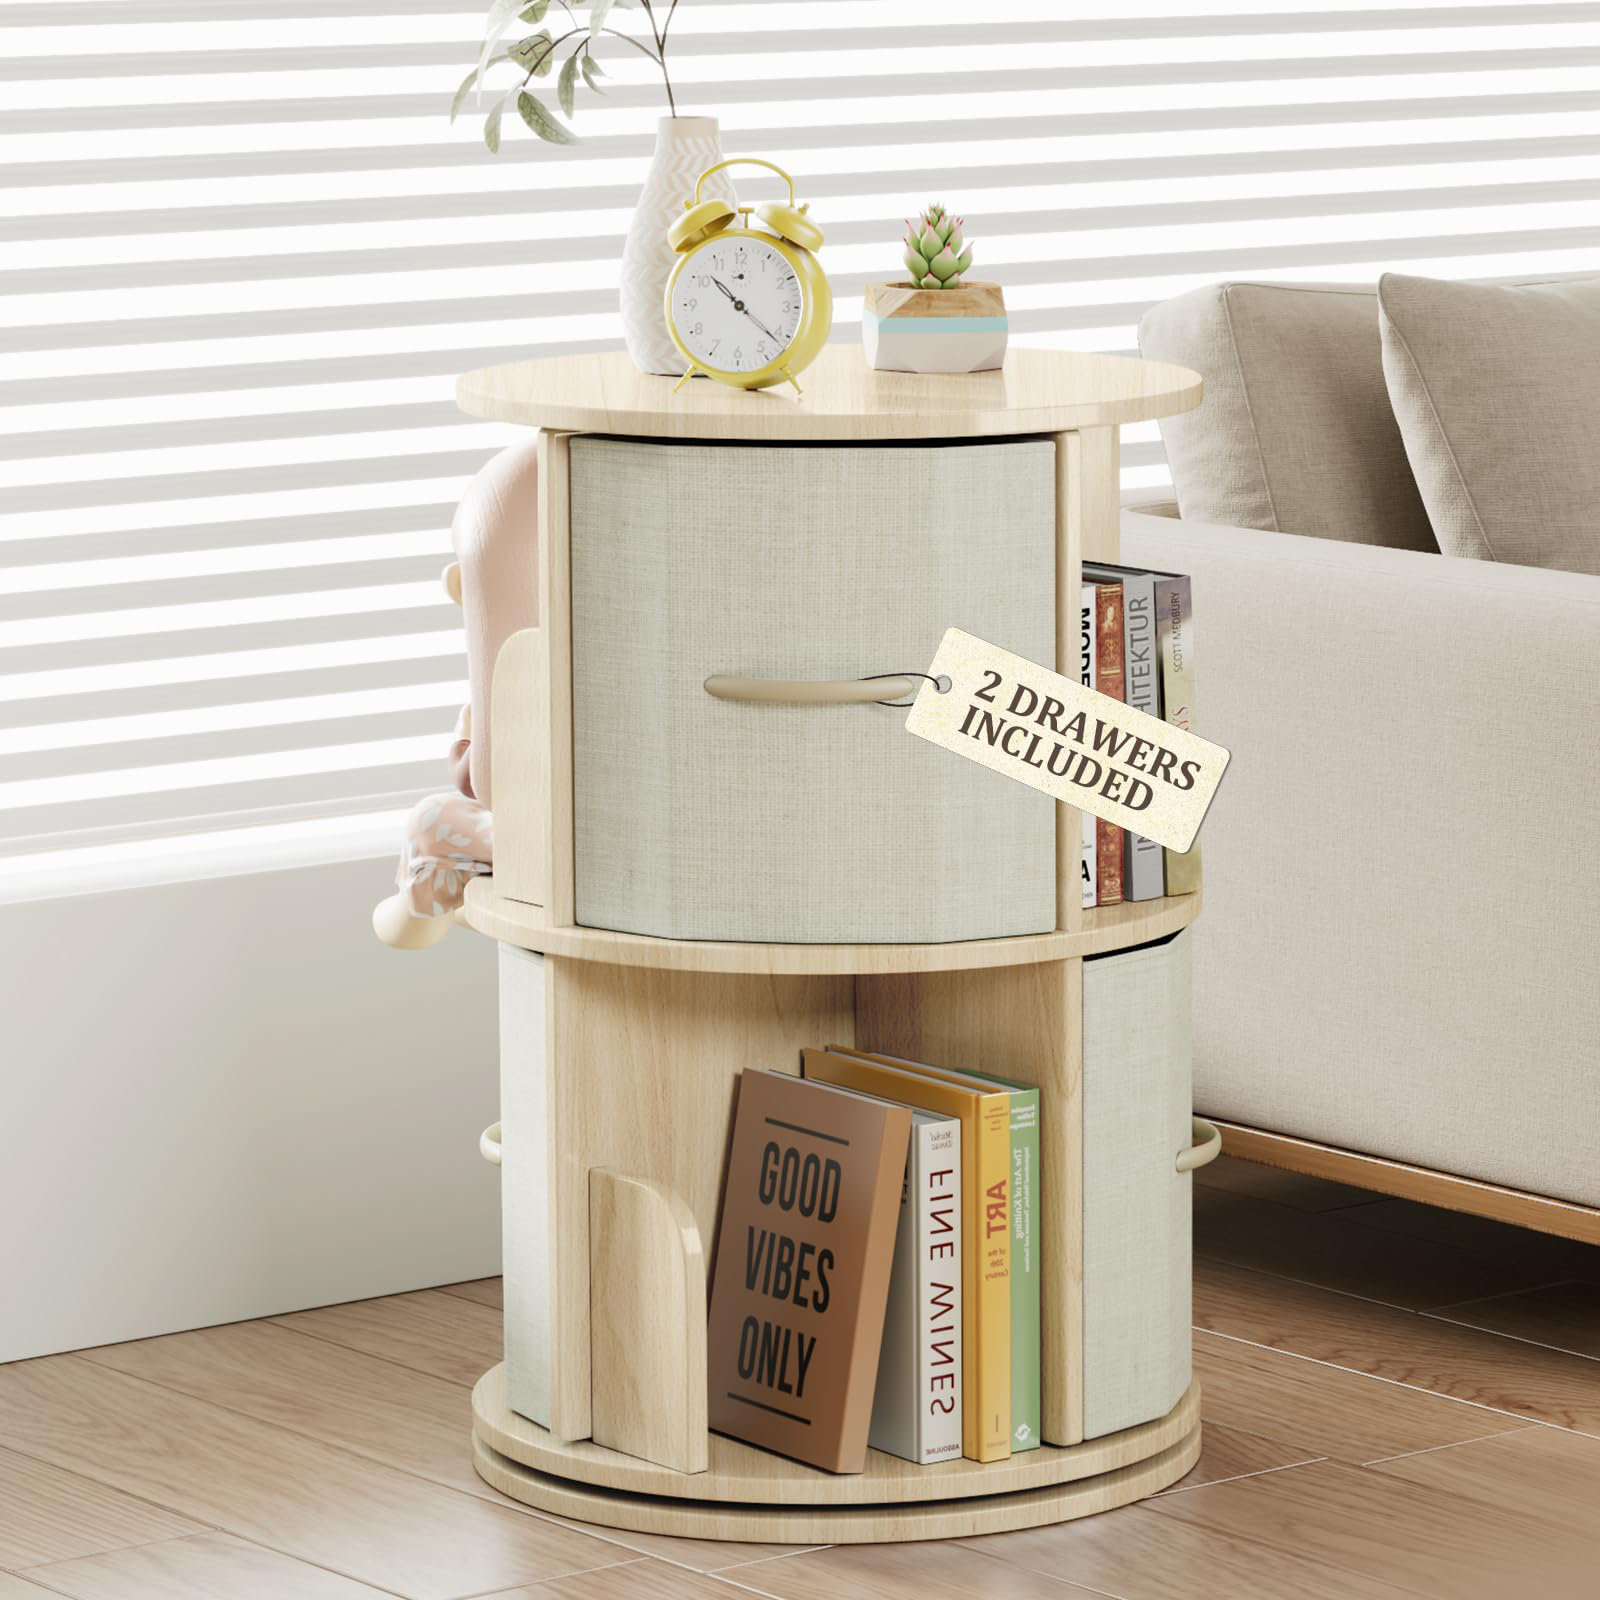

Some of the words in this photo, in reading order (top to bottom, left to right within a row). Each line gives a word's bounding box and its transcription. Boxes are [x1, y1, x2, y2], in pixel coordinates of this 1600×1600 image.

[714, 259, 725, 271] 11
[735, 253, 748, 265] 12
[697, 275, 711, 288] 10
[776, 277, 785, 290] 2
[688, 299, 698, 312] 9
[782, 301, 791, 313] 3
[695, 322, 703, 335] 8
[774, 325, 783, 337] 4
[712, 339, 721, 352] 7
[733, 346, 742, 358] 6
[757, 341, 766, 353] 5
[1170, 591, 1181, 640] MEDBURY
[1173, 643, 1183, 673] SCOTT
[759, 1141, 842, 1224] GOOD
[745, 1225, 835, 1314] VIBES
[737, 1316, 817, 1399] ONLY
